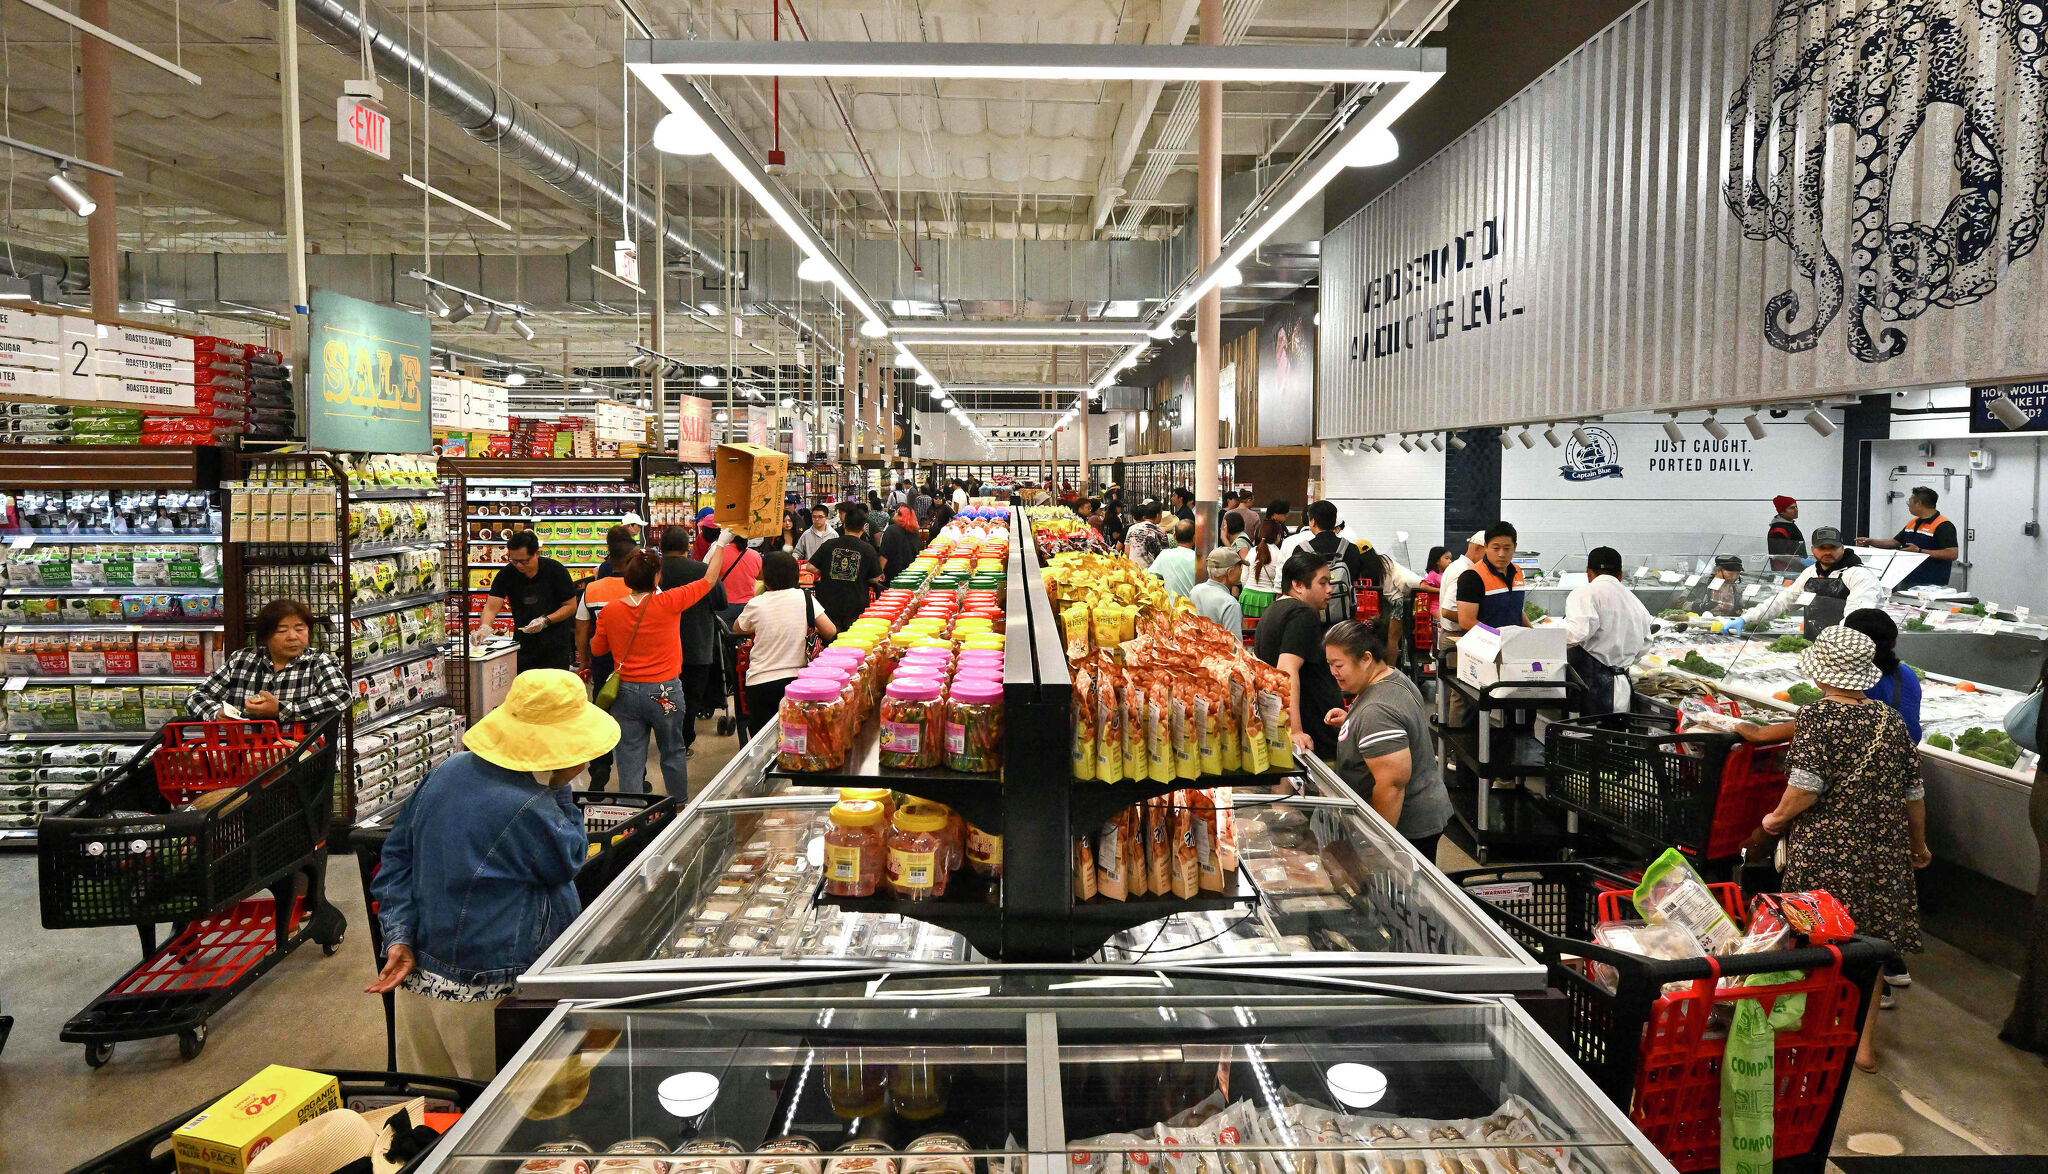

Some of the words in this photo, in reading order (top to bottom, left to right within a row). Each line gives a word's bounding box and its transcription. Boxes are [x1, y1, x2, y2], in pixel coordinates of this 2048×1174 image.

[356, 106, 385, 153] EXIT
[624, 252, 635, 278] EXIT
[0, 344, 20, 352] SUGAR
[125, 333, 148, 344] ROASTED
[149, 336, 172, 347] SEAWEED
[72, 341, 88, 377] 2
[126, 358, 148, 368] ROASTED
[149, 361, 172, 371] SEAWEED
[4, 371, 16, 381] TEA
[322, 340, 422, 411] SALE
[126, 384, 148, 393] ROASTED
[150, 386, 172, 395] SEAWEED
[464, 394, 470, 414] 3
[2010, 397, 2032, 407] IKE
[2036, 397, 2046, 405] IT
[682, 416, 709, 442] SALE
[1654, 440, 1686, 453] JUST
[1694, 440, 1751, 453] CAUGHT.
[1650, 458, 1702, 472] PORTED
[1710, 458, 1753, 472] DAILY.
[1572, 470, 1597, 480] Captain
[1598, 467, 1612, 476] Blue
[1803, 910, 1817, 926] SHIN
[297, 1085, 335, 1118] ORGANIC
[1732, 1135, 1772, 1152] COMPO
[178, 1148, 200, 1159] VALUE
[202, 1147, 210, 1162] 6
[211, 1153, 238, 1165] PACK
